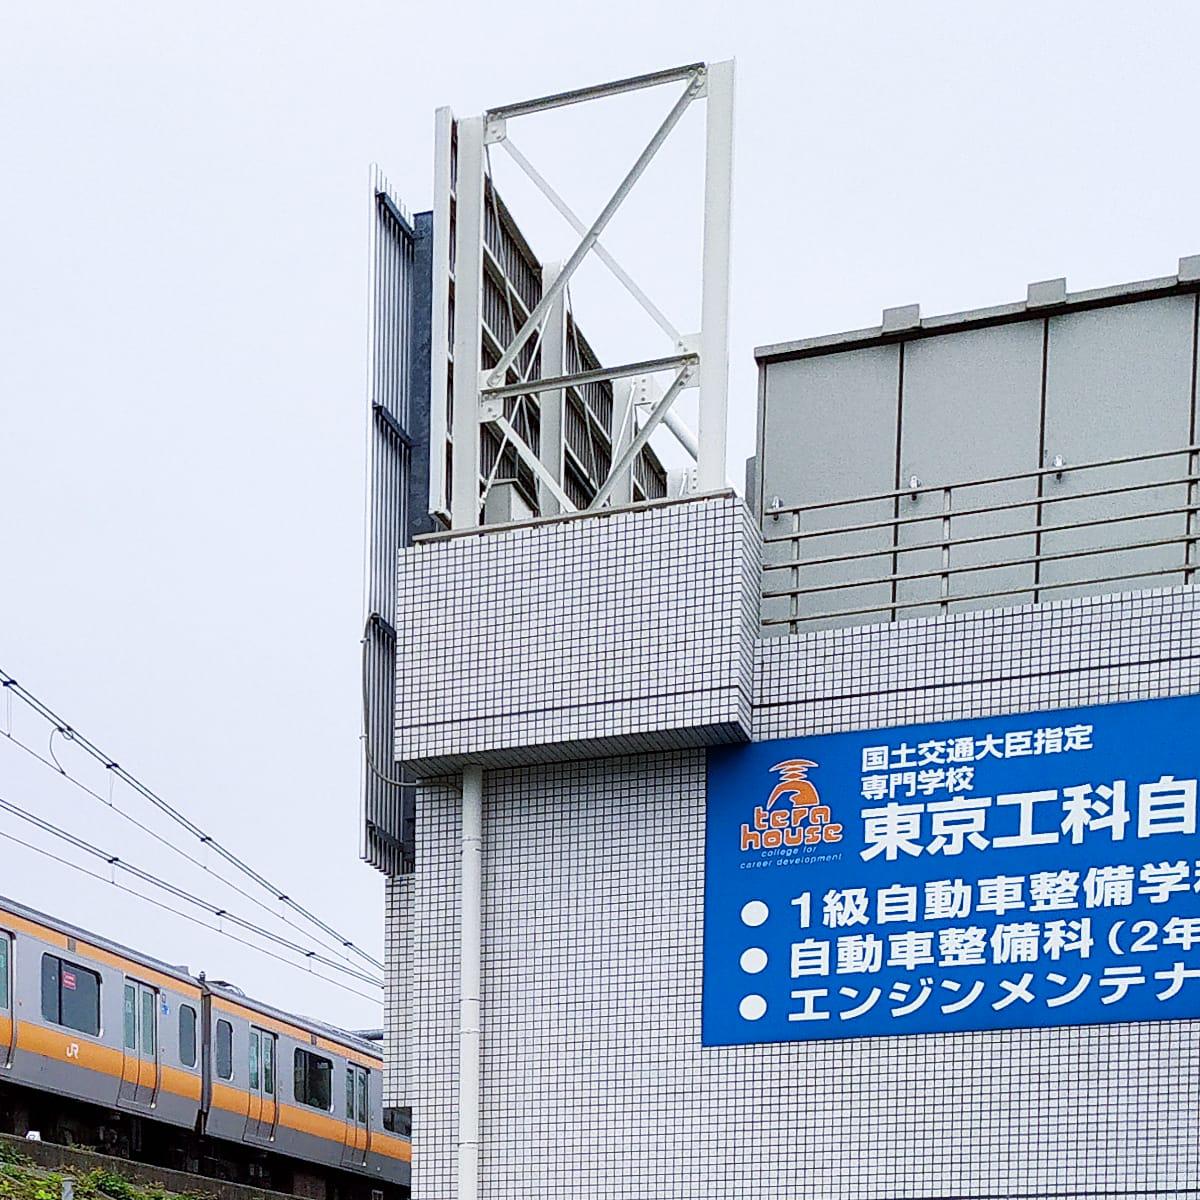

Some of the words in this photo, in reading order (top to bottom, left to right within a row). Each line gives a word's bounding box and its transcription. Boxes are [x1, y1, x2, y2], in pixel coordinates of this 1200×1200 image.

[861, 724, 1094, 773] 国土交通大臣指定
[860, 765, 974, 799] 専門学校
[860, 774, 1198, 862] 東京工科自
[739, 823, 843, 851] house
[760, 846, 799, 858] college
[802, 845, 817, 854] for
[739, 859, 773, 870] career
[776, 853, 843, 867] development
[790, 860, 1200, 929] 1級自動車整備学
[66, 1043, 79, 1060] JR
